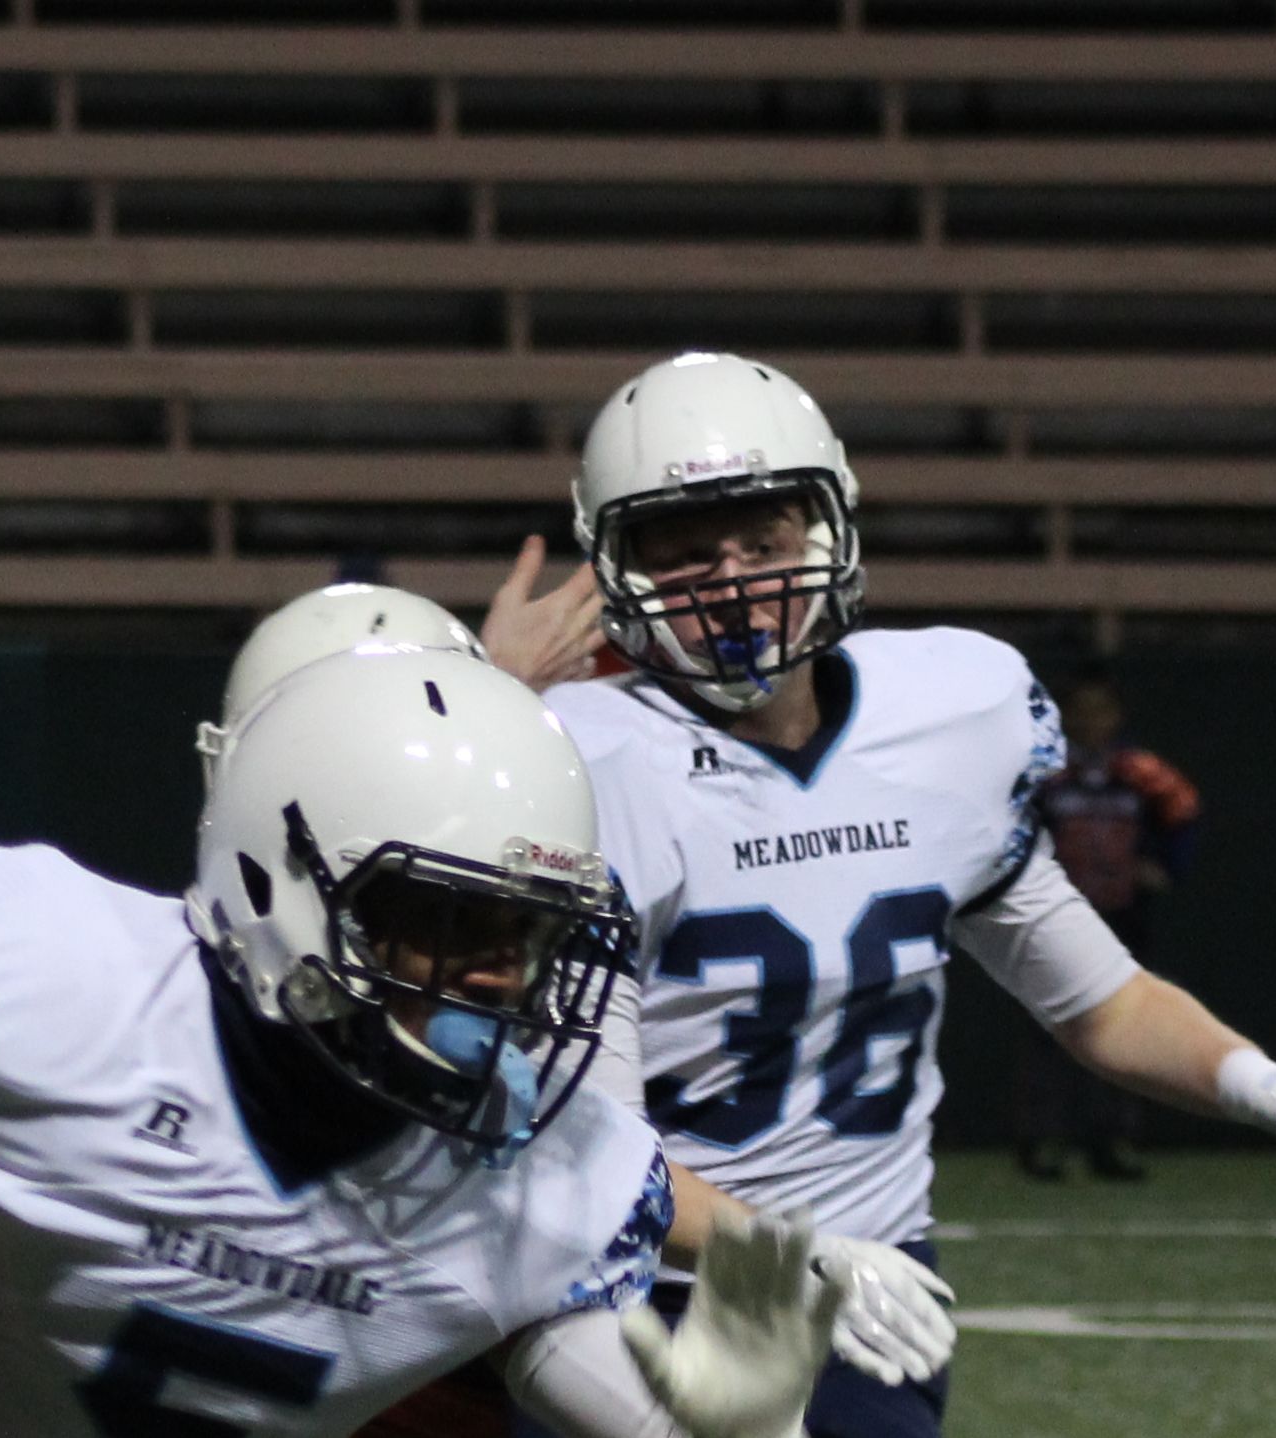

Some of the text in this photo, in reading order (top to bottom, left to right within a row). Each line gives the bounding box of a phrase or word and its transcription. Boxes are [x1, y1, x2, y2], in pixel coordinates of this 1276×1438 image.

[733, 819, 911, 871] MEADOWDALE
[644, 886, 951, 1151] 36
[140, 1222, 382, 1316] MEADOWDALE
